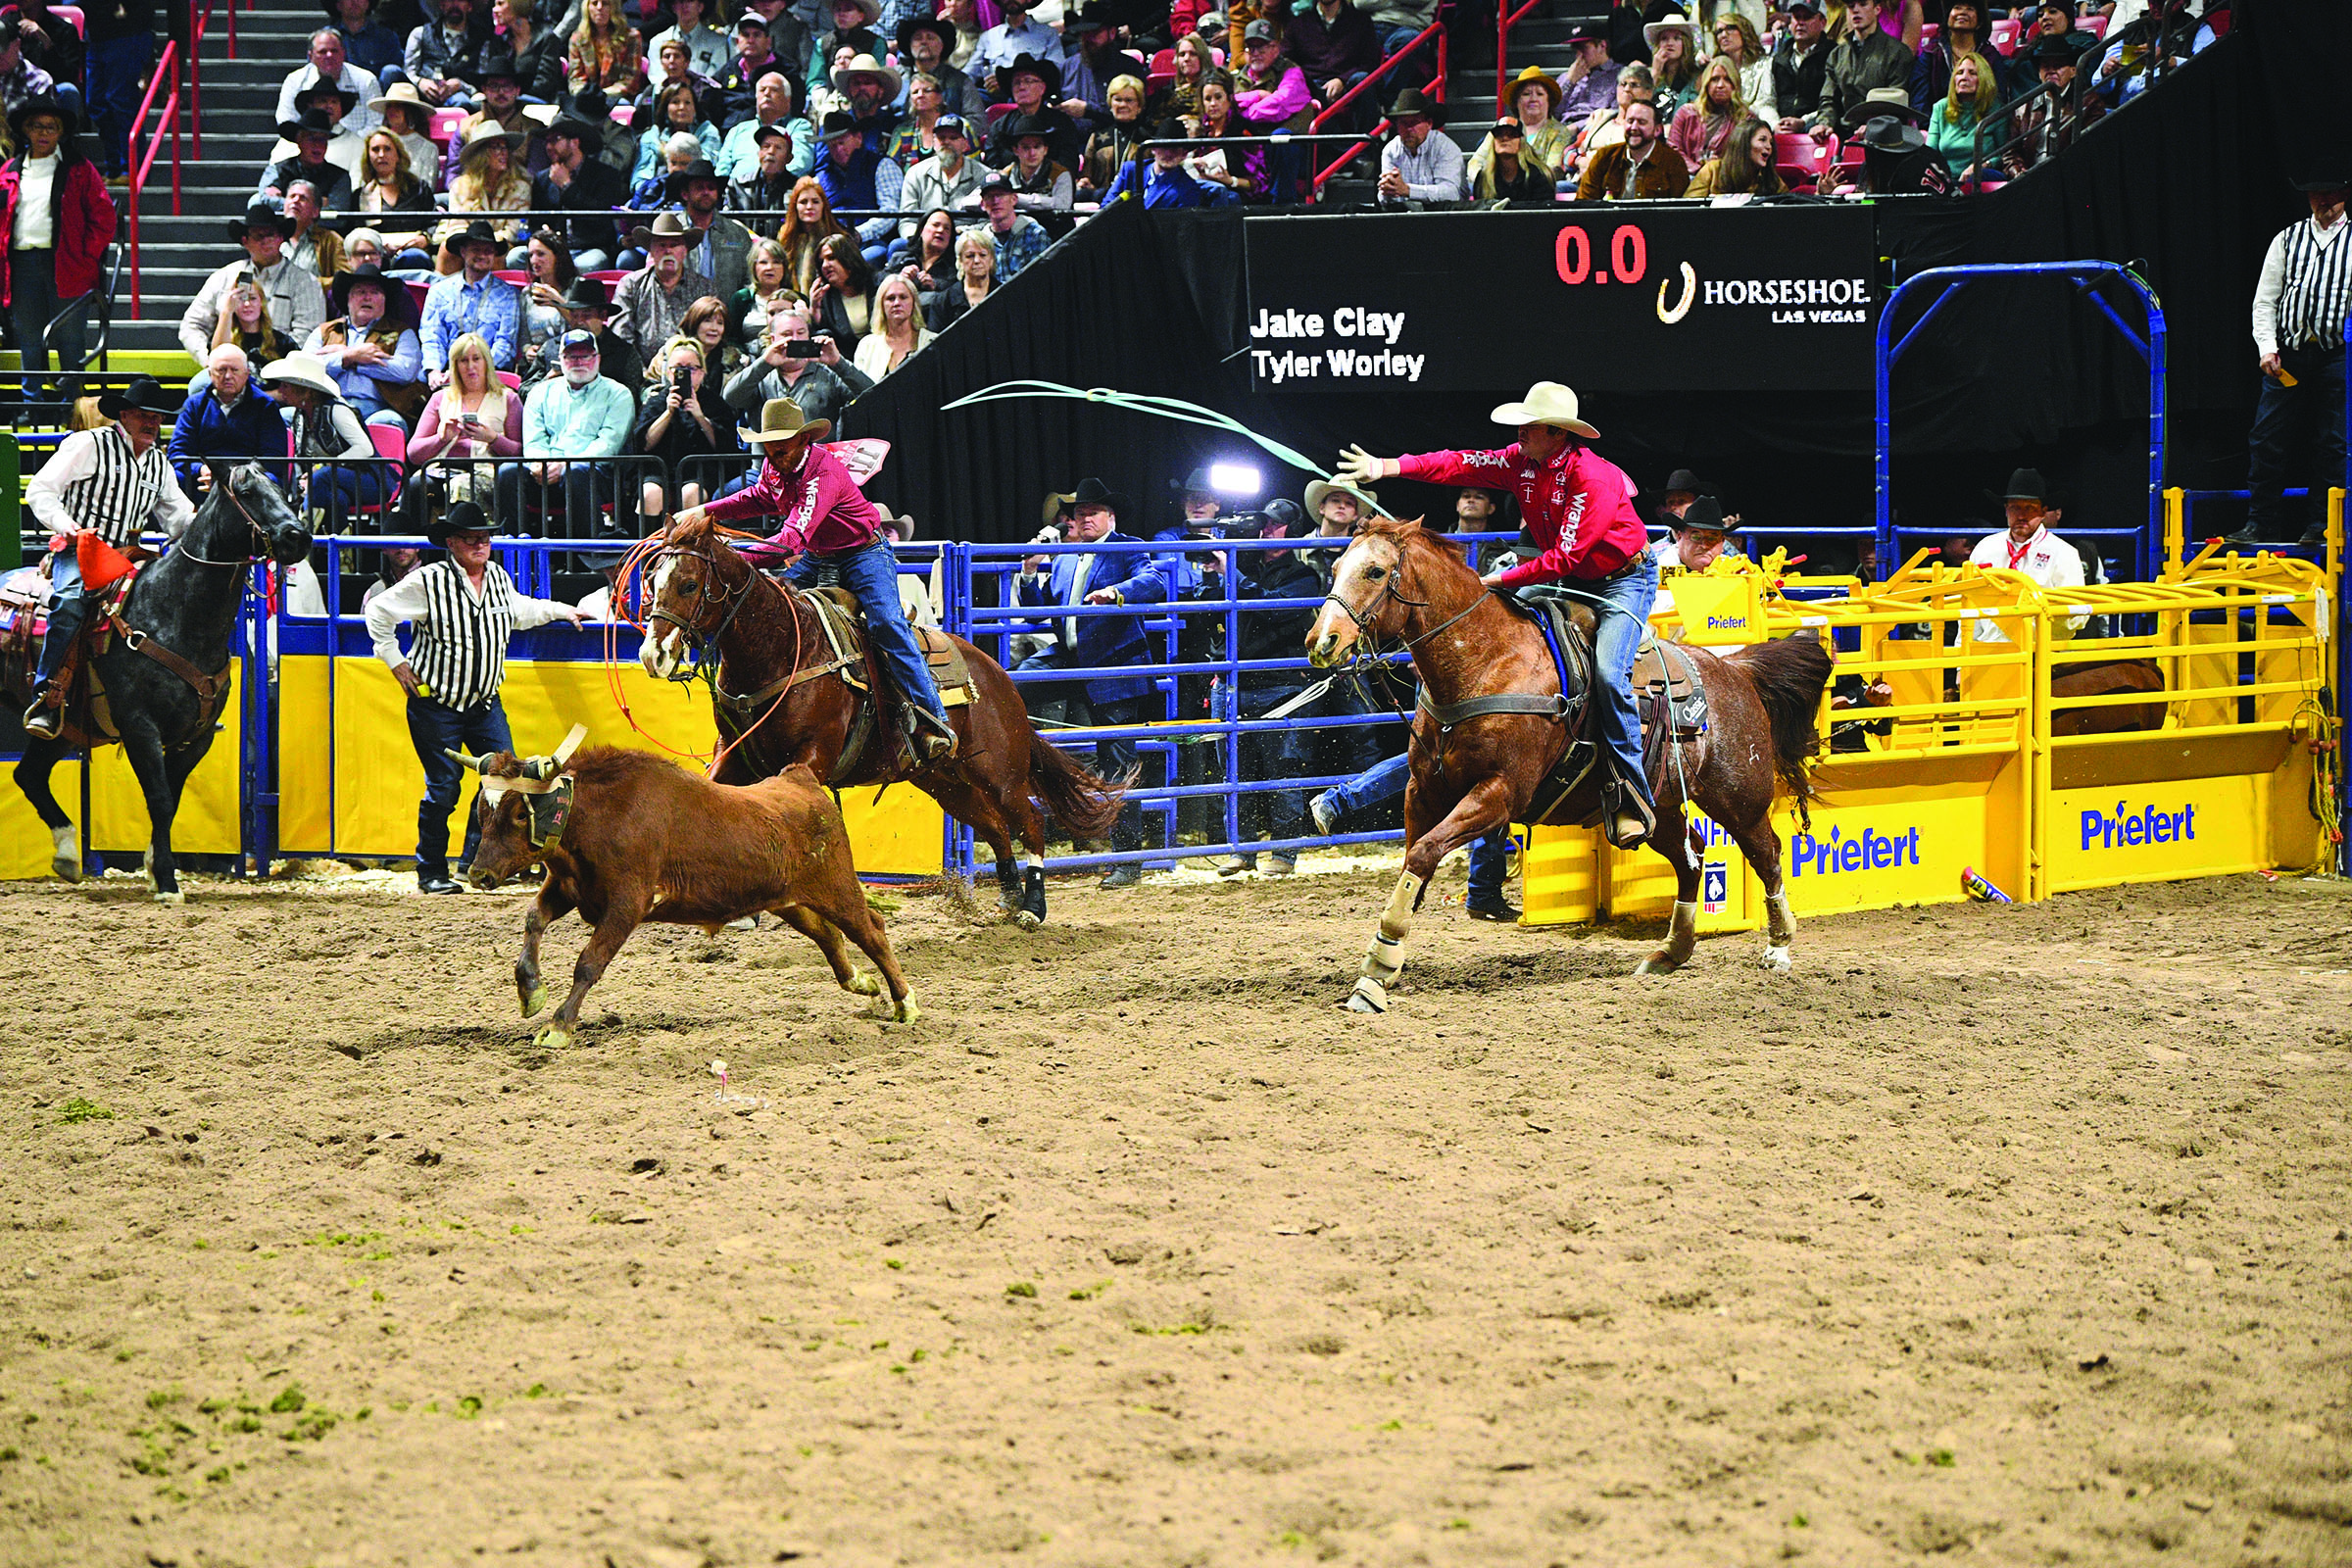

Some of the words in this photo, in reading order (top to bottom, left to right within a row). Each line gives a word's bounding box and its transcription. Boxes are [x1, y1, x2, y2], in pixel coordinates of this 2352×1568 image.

[1555, 224, 1646, 284] 0.0
[1703, 279, 1867, 305] HORSESHOE
[1250, 308, 1324, 338] Jake
[1333, 307, 1405, 344] Clay
[1772, 311, 1806, 323] LAS
[1809, 311, 1866, 323] VEGAS
[1250, 350, 1322, 384] Tyler
[1326, 348, 1425, 382] Worley
[795, 476, 820, 533] Wrangler
[1560, 492, 1588, 555] Wrangle
[1707, 614, 1746, 629] Priefert
[2081, 802, 2195, 851] Priefert
[1791, 824, 1920, 877] Priefert
